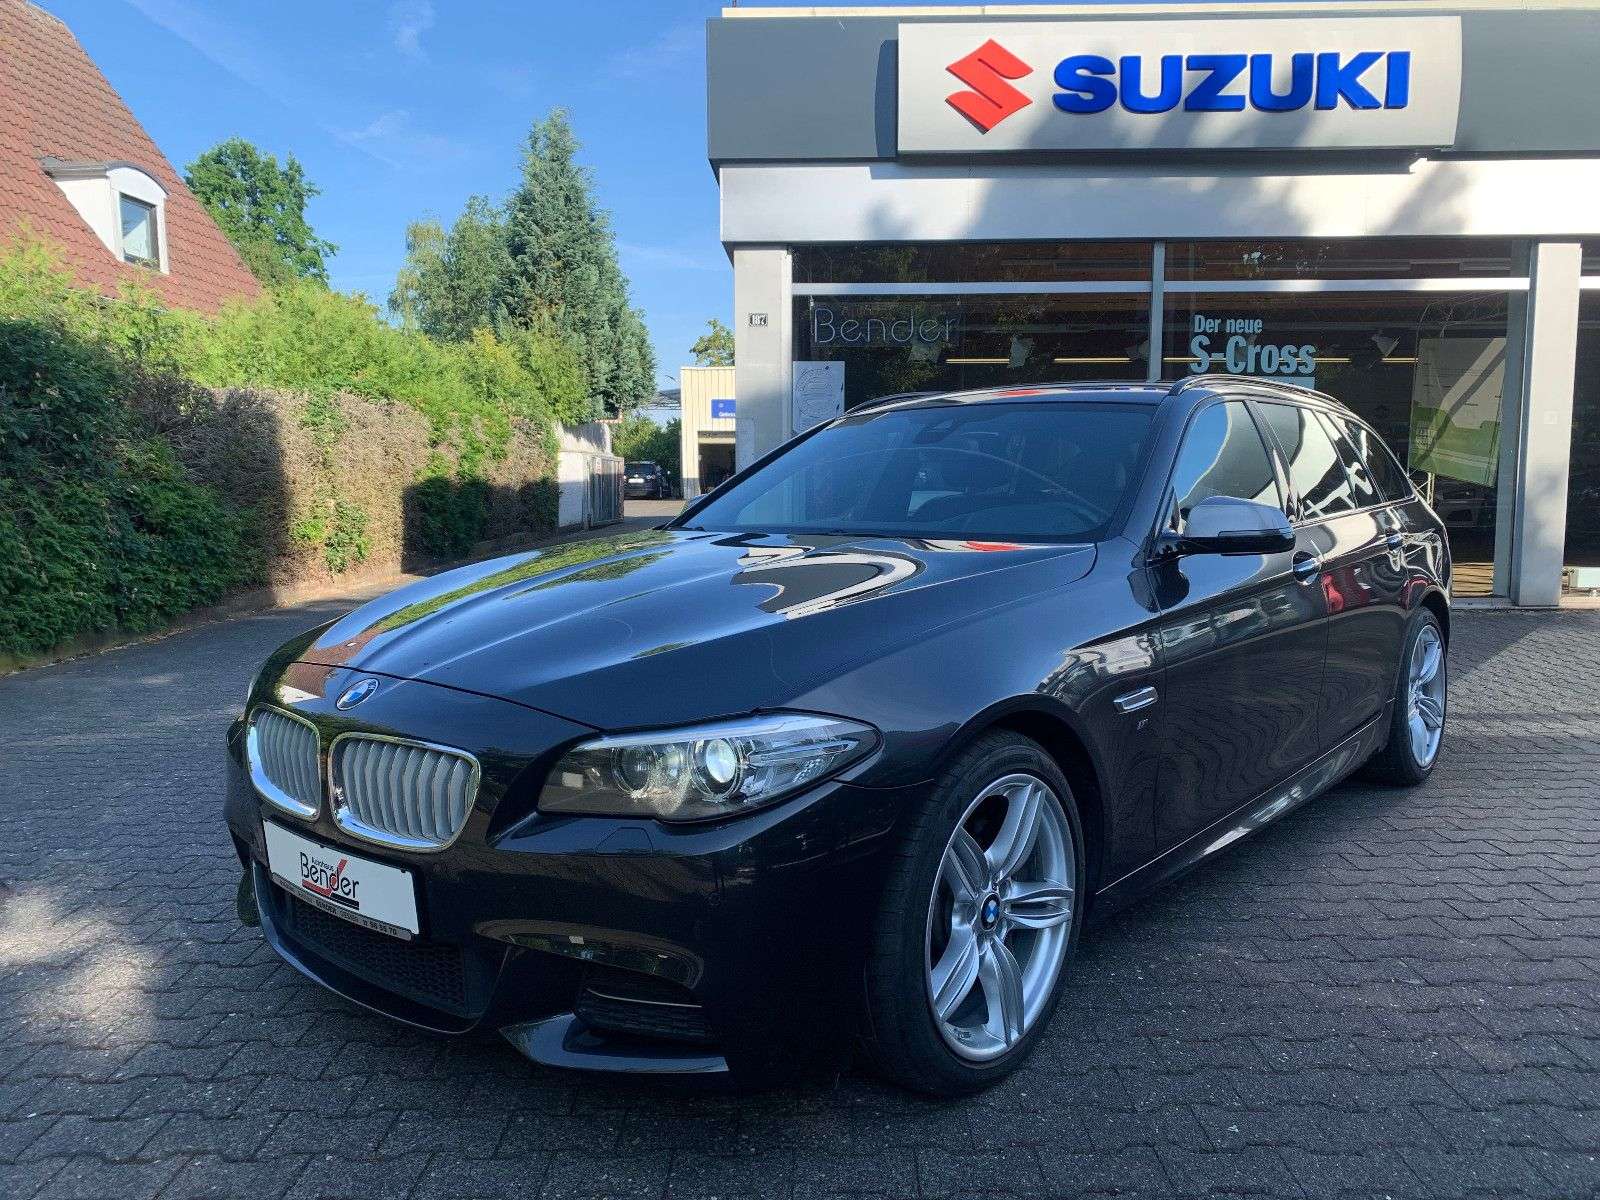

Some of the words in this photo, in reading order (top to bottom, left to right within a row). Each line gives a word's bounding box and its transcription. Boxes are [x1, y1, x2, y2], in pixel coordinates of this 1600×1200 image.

[1052, 51, 1411, 114] SUZUKI
[813, 308, 956, 343] Bender
[1194, 314, 1221, 333] Der
[1226, 318, 1263, 334] neue
[1190, 334, 1317, 375] S-Cross
[300, 852, 360, 899] Bender
